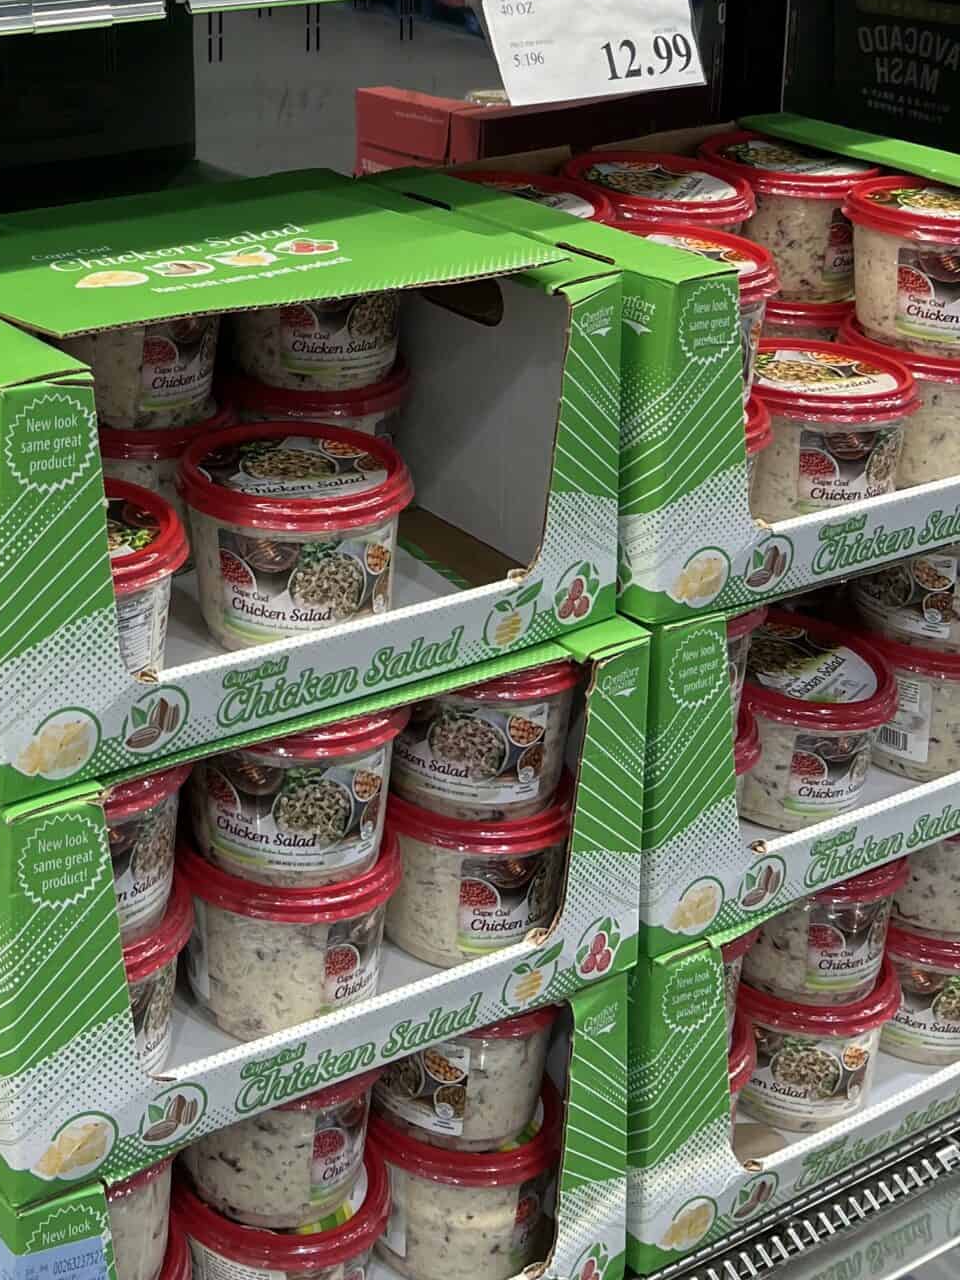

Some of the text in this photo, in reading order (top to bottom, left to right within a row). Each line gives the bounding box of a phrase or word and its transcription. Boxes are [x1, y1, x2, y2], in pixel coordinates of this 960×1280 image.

[501, 2, 535, 15] 40 OZ
[601, 33, 692, 80] 12.99
[292, 338, 379, 354] Chicken Salad
[26, 413, 78, 432] New look
[21, 435, 82, 454] same great
[29, 453, 76, 475] product!
[232, 584, 269, 602] Cape Cod
[232, 598, 333, 622] Chicken Salad
[217, 626, 465, 728] Chicken Salad
[798, 786, 844, 799] Chicken
[216, 815, 317, 849] Chicken Salad
[38, 833, 88, 853] New look
[33, 850, 93, 875] same great
[42, 869, 89, 893] product!
